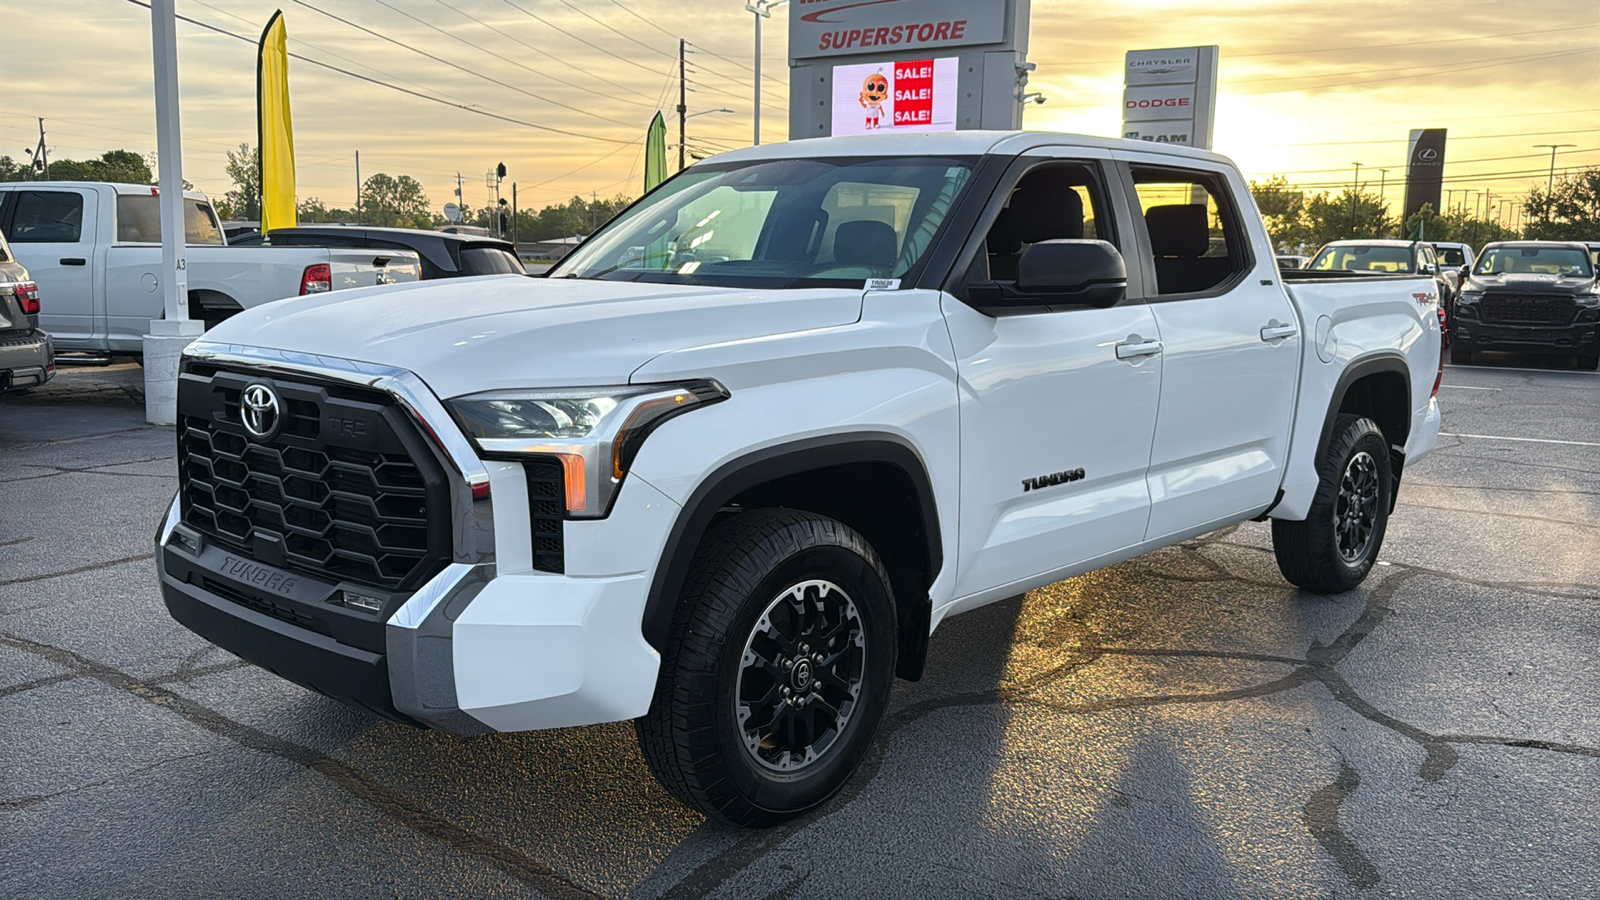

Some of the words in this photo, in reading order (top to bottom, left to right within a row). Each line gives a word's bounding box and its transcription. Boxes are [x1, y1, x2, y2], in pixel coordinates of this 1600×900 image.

[818, 20, 967, 50] SUPERSTORE
[1129, 58, 1191, 67] CHRYSLER
[895, 66, 932, 80] SALE!
[895, 88, 931, 101] SALE!
[1125, 97, 1190, 109] DODGE
[894, 110, 930, 122] SALE!
[176, 258, 186, 271] A3
[329, 415, 366, 437] TRD
[1021, 467, 1086, 492] TUNDRA
[220, 556, 298, 594] TUNDRA
